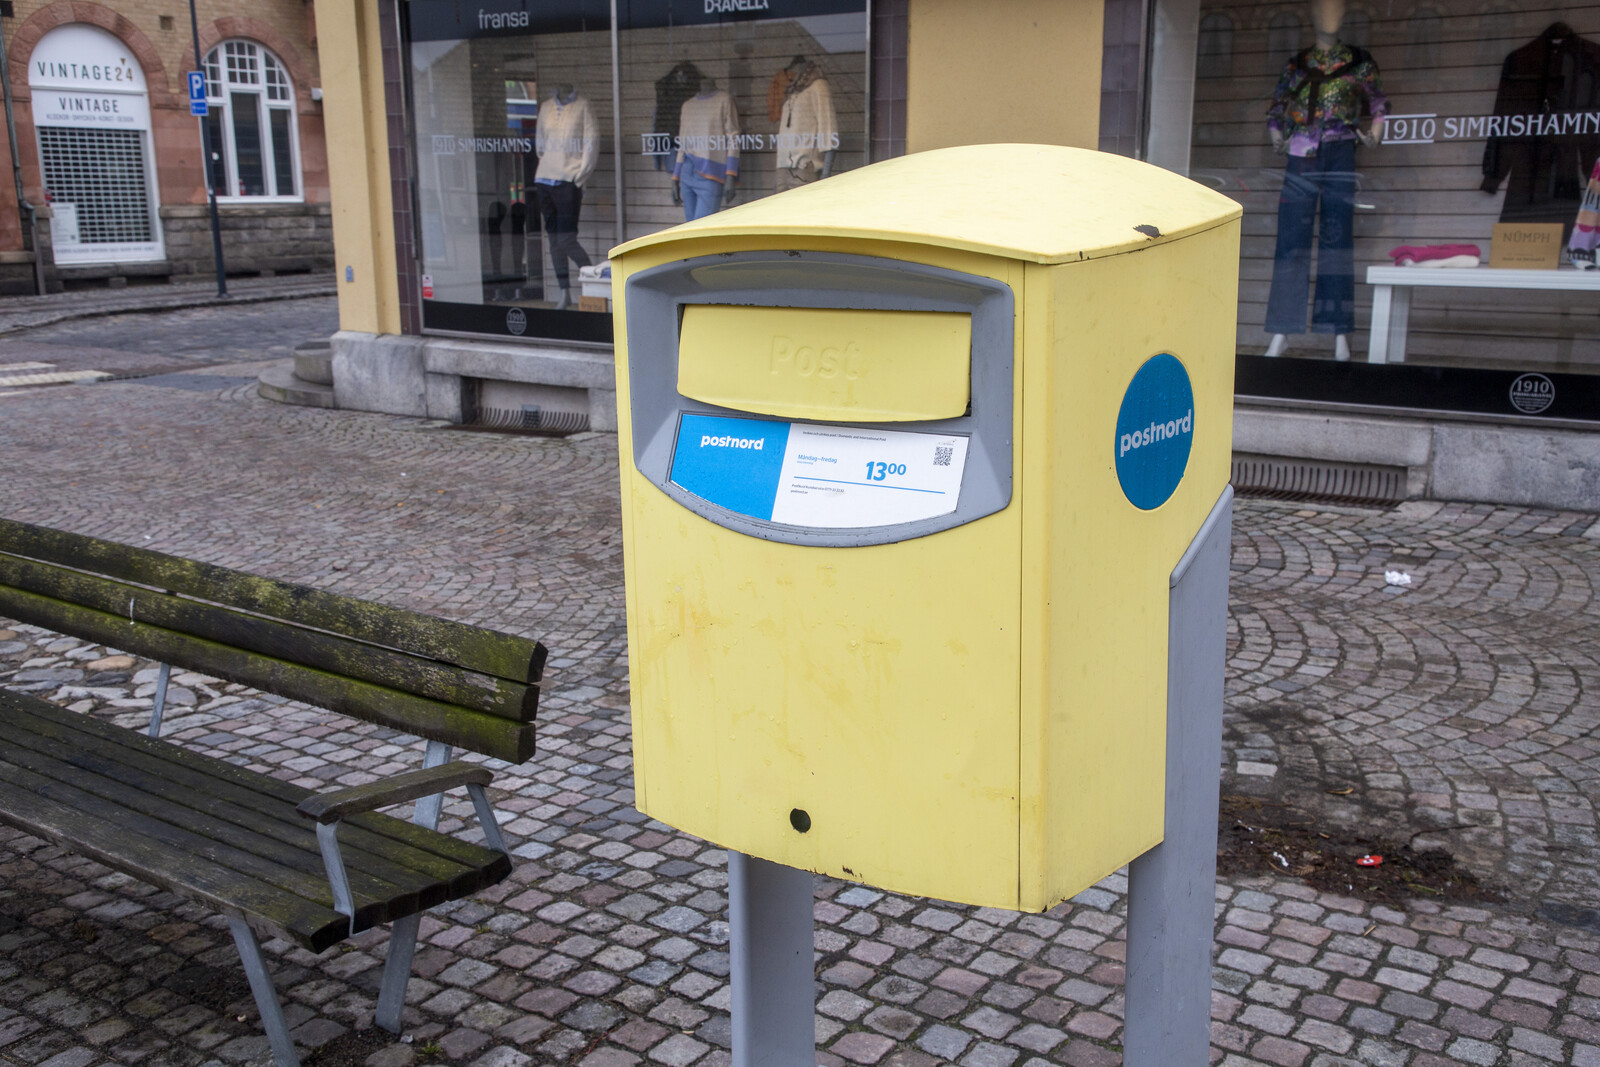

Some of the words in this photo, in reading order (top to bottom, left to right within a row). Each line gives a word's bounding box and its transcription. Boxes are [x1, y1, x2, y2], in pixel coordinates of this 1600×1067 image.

[479, 9, 529, 29] fransa
[191, 74, 202, 98] P
[58, 97, 119, 113] VINTAGE
[1383, 117, 1436, 141] 1910
[458, 137, 532, 153] SIMRISHAMNS
[641, 135, 671, 152] 1910
[674, 134, 764, 151] SIMRISHAMNS
[769, 132, 840, 150] MODEHUS
[769, 335, 860, 380] Post
[1517, 380, 1550, 393] 1910
[700, 435, 765, 450] postnord
[1120, 408, 1192, 458] postnord
